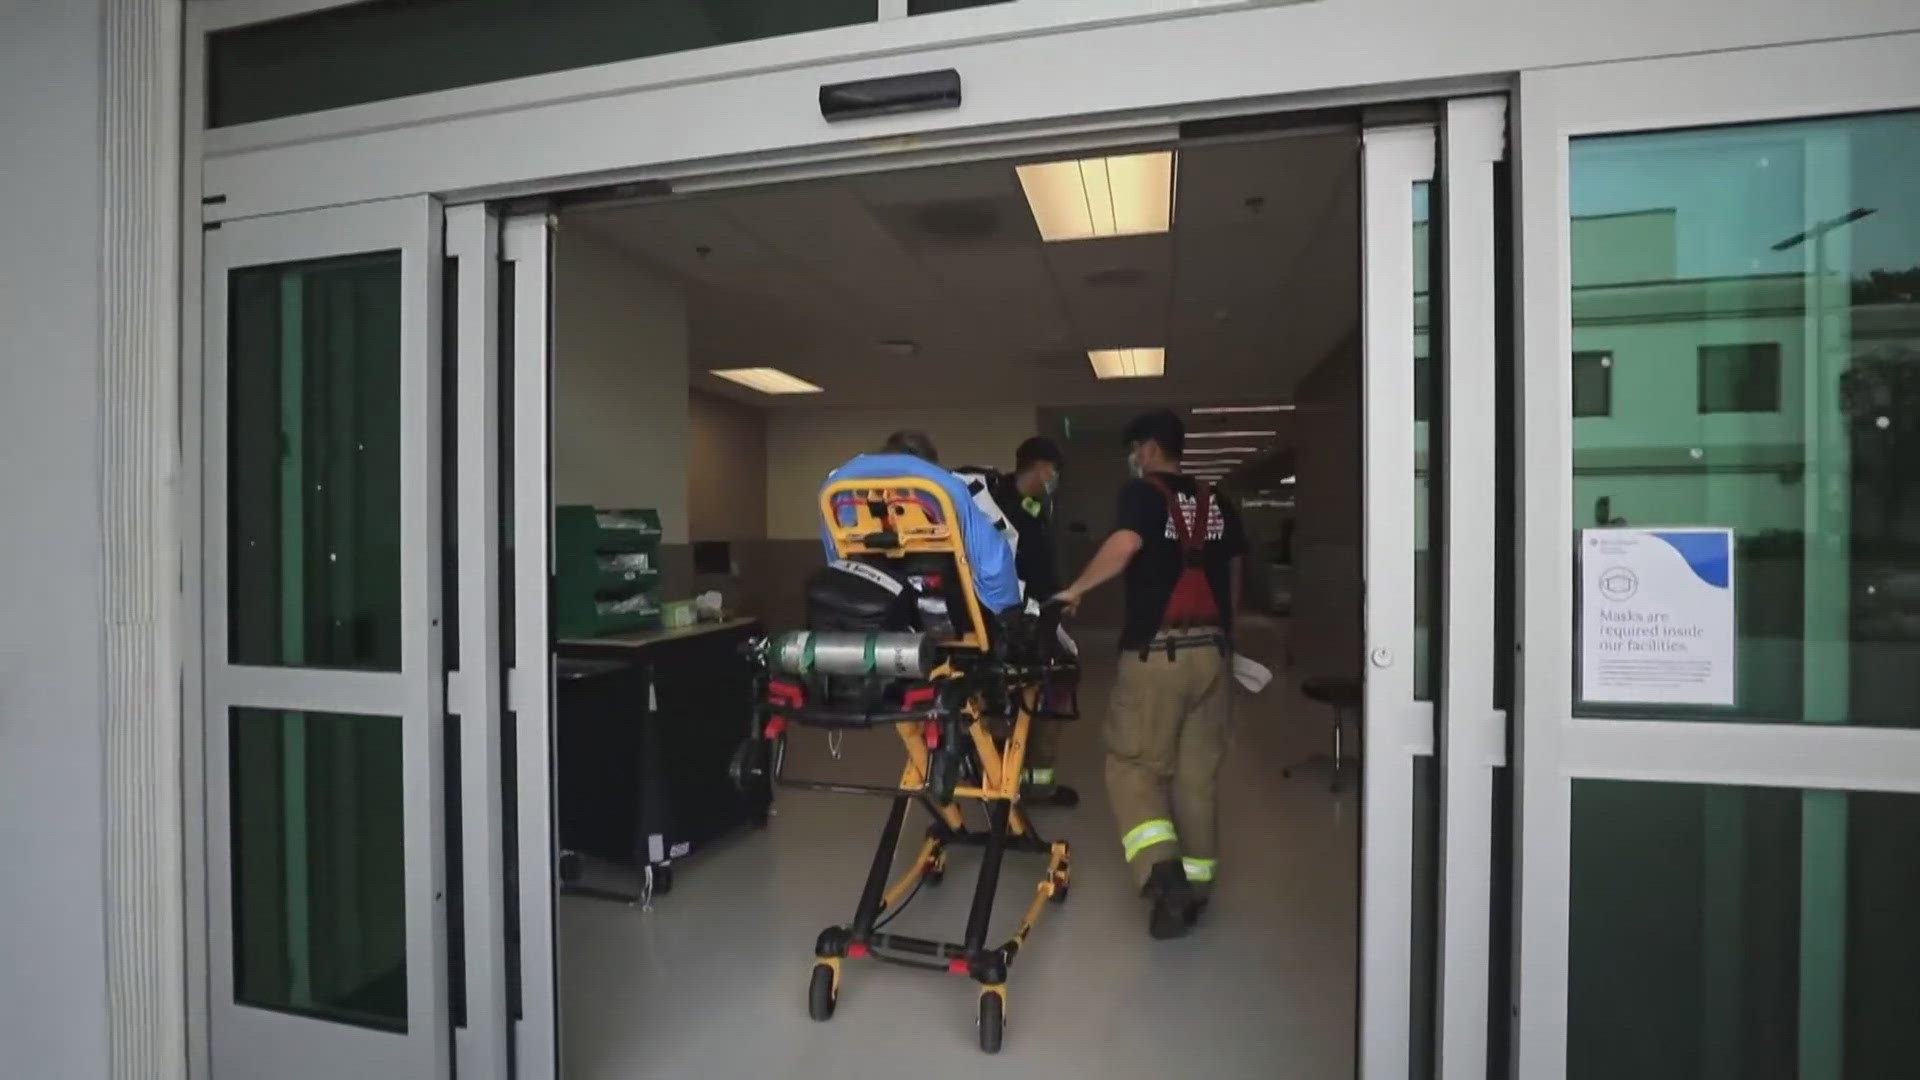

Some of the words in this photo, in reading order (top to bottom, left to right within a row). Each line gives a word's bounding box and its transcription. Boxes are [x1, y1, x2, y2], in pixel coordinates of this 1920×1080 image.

[1600, 609, 1643, 622] Masks
[1647, 612, 1668, 622] are
[1600, 624, 1659, 638] required
[1663, 624, 1704, 637] inside
[1600, 641, 1622, 651] our
